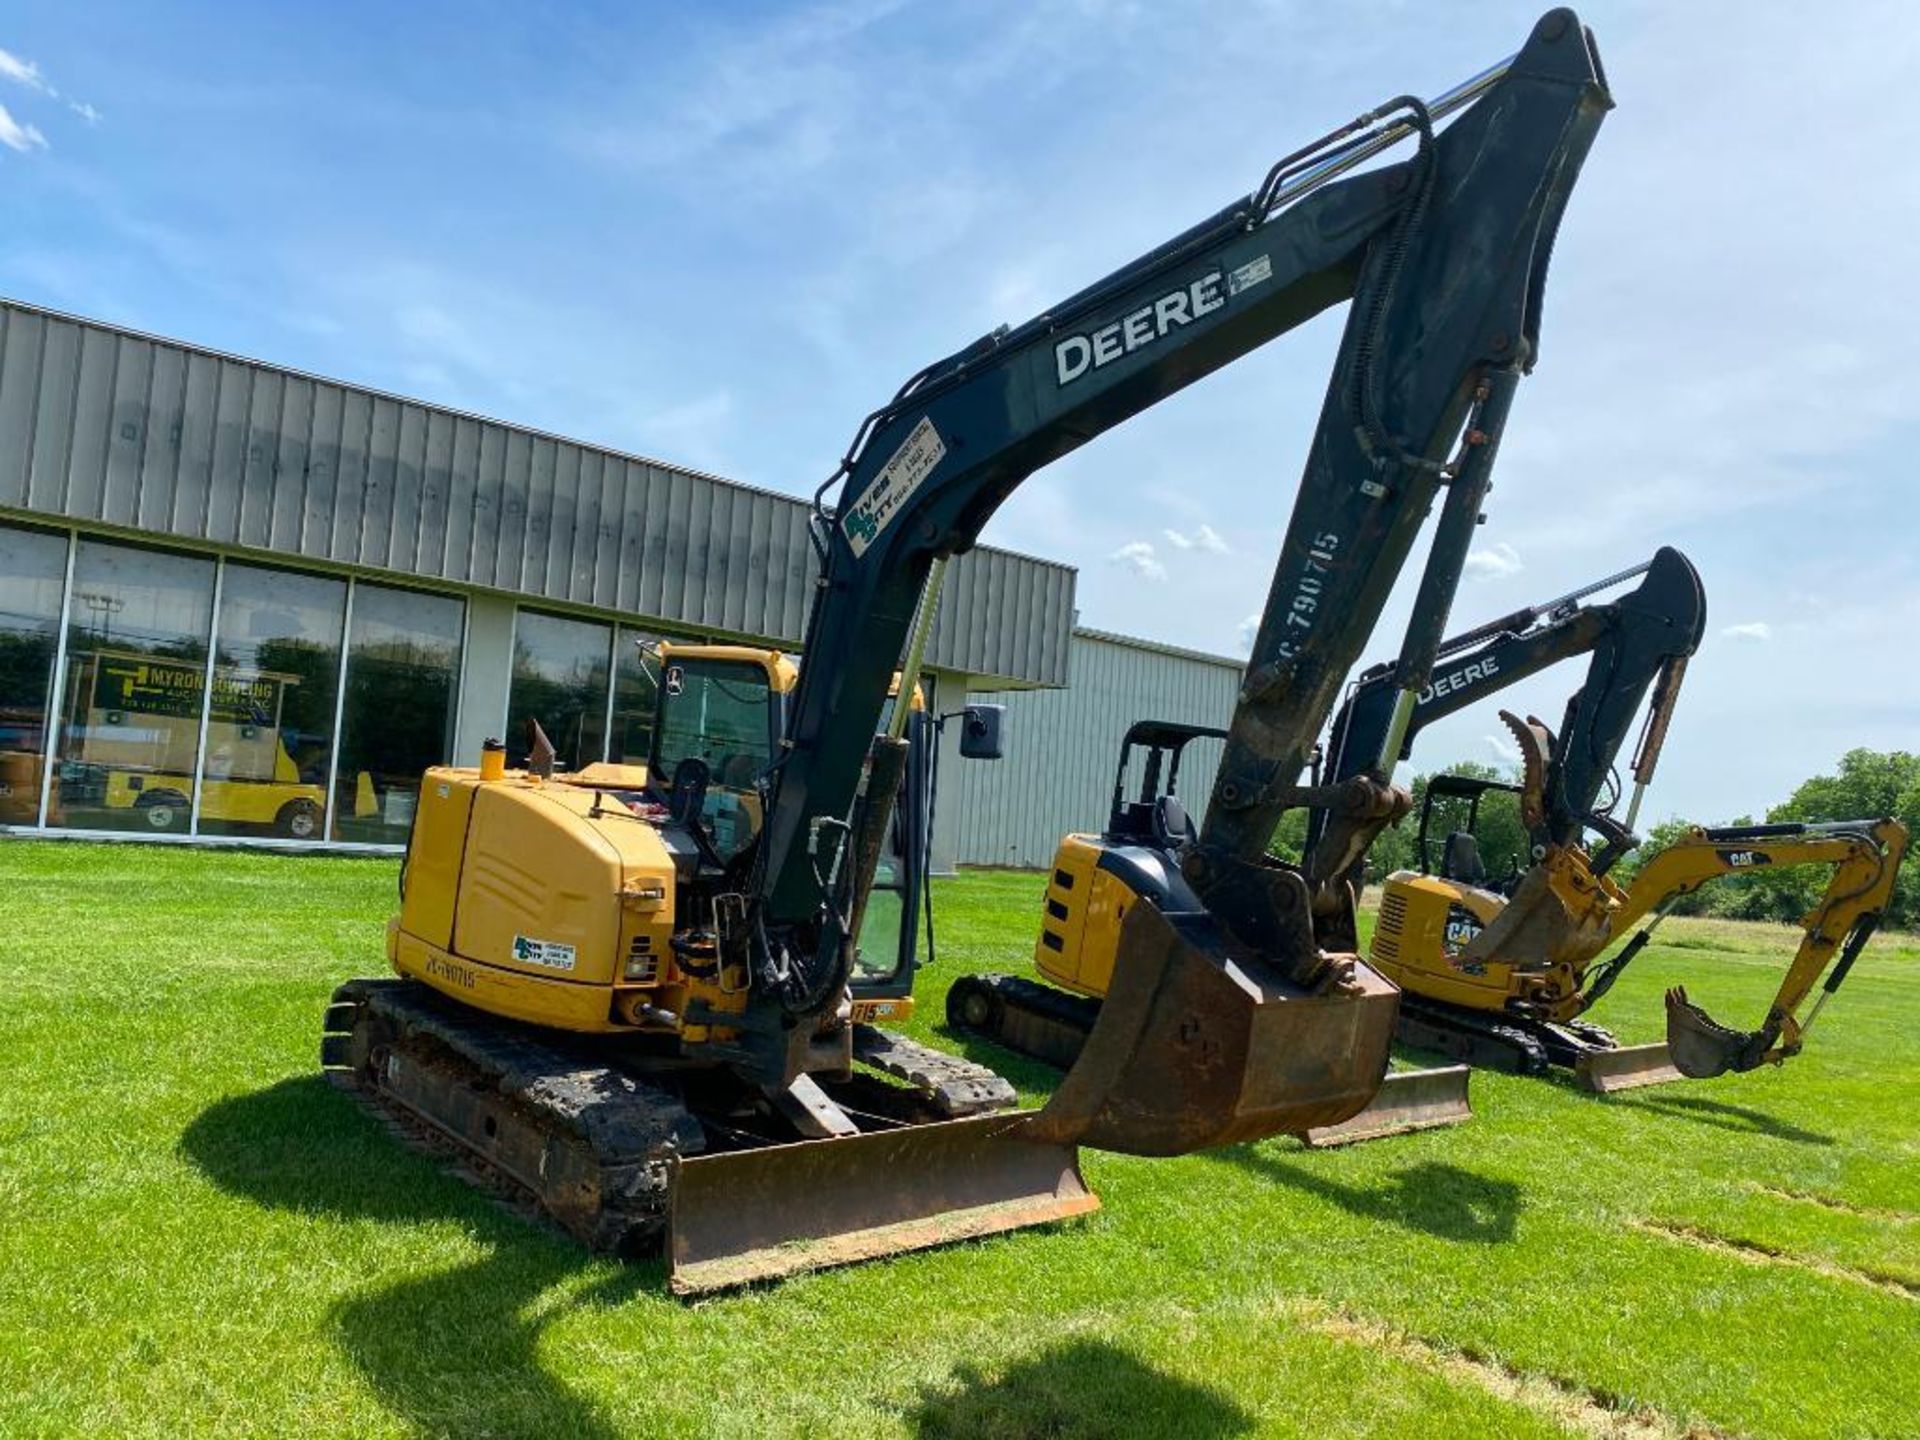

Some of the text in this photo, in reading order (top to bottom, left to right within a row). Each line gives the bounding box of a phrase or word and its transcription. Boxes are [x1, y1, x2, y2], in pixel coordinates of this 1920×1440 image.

[1056, 271, 1225, 385] DEERE
[152, 668, 204, 690] MYRON
[1416, 656, 1499, 705] DEERE
[1730, 851, 1754, 866] CAT
[1447, 922, 1482, 943] CAT
